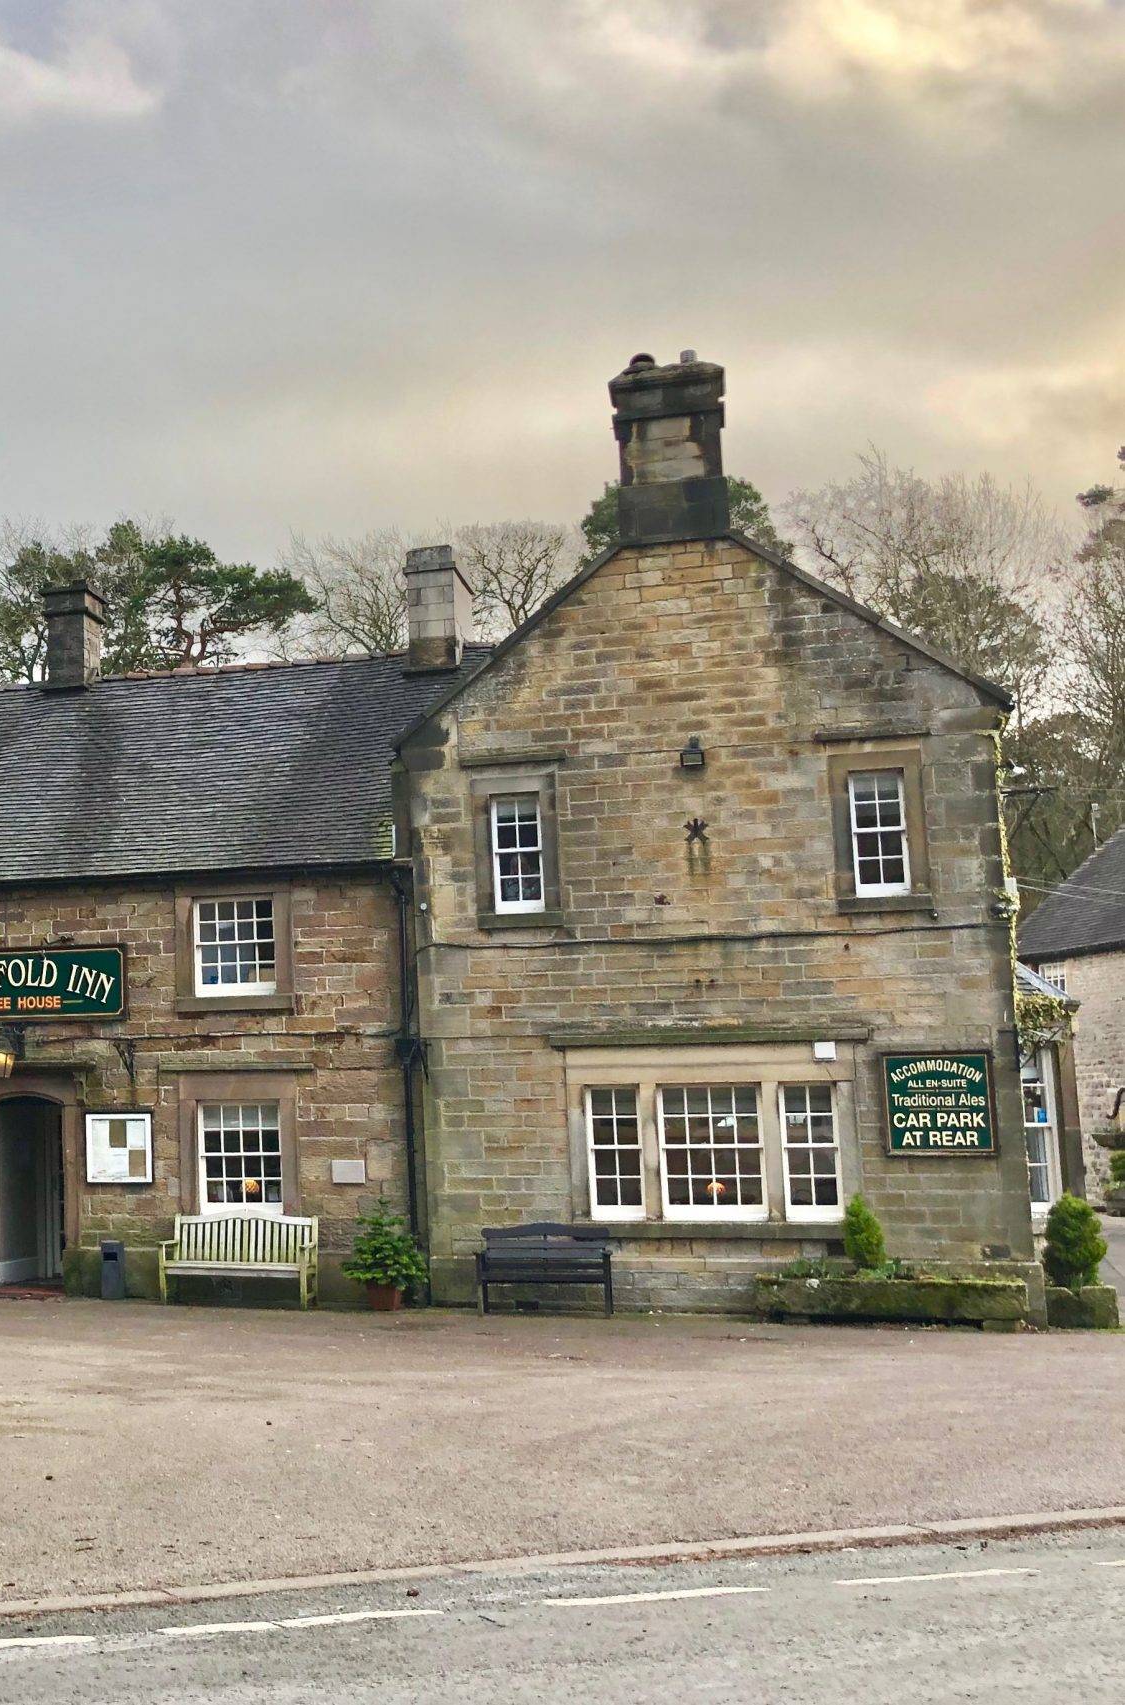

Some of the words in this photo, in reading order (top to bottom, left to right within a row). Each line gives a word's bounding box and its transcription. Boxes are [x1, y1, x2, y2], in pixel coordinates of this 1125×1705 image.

[66, 964, 115, 1004] INN
[17, 995, 62, 1009] HOUSE
[890, 1059, 983, 1083] ACCOMMODATION
[907, 1079, 924, 1088] ALL
[926, 1079, 967, 1088] EN-SUITE
[892, 1093, 955, 1107] Traditional
[958, 1093, 985, 1106] Ales
[893, 1112, 932, 1128] CAR
[936, 1112, 986, 1128] PARK
[902, 1131, 924, 1146] AT
[929, 1131, 979, 1146] REAR
